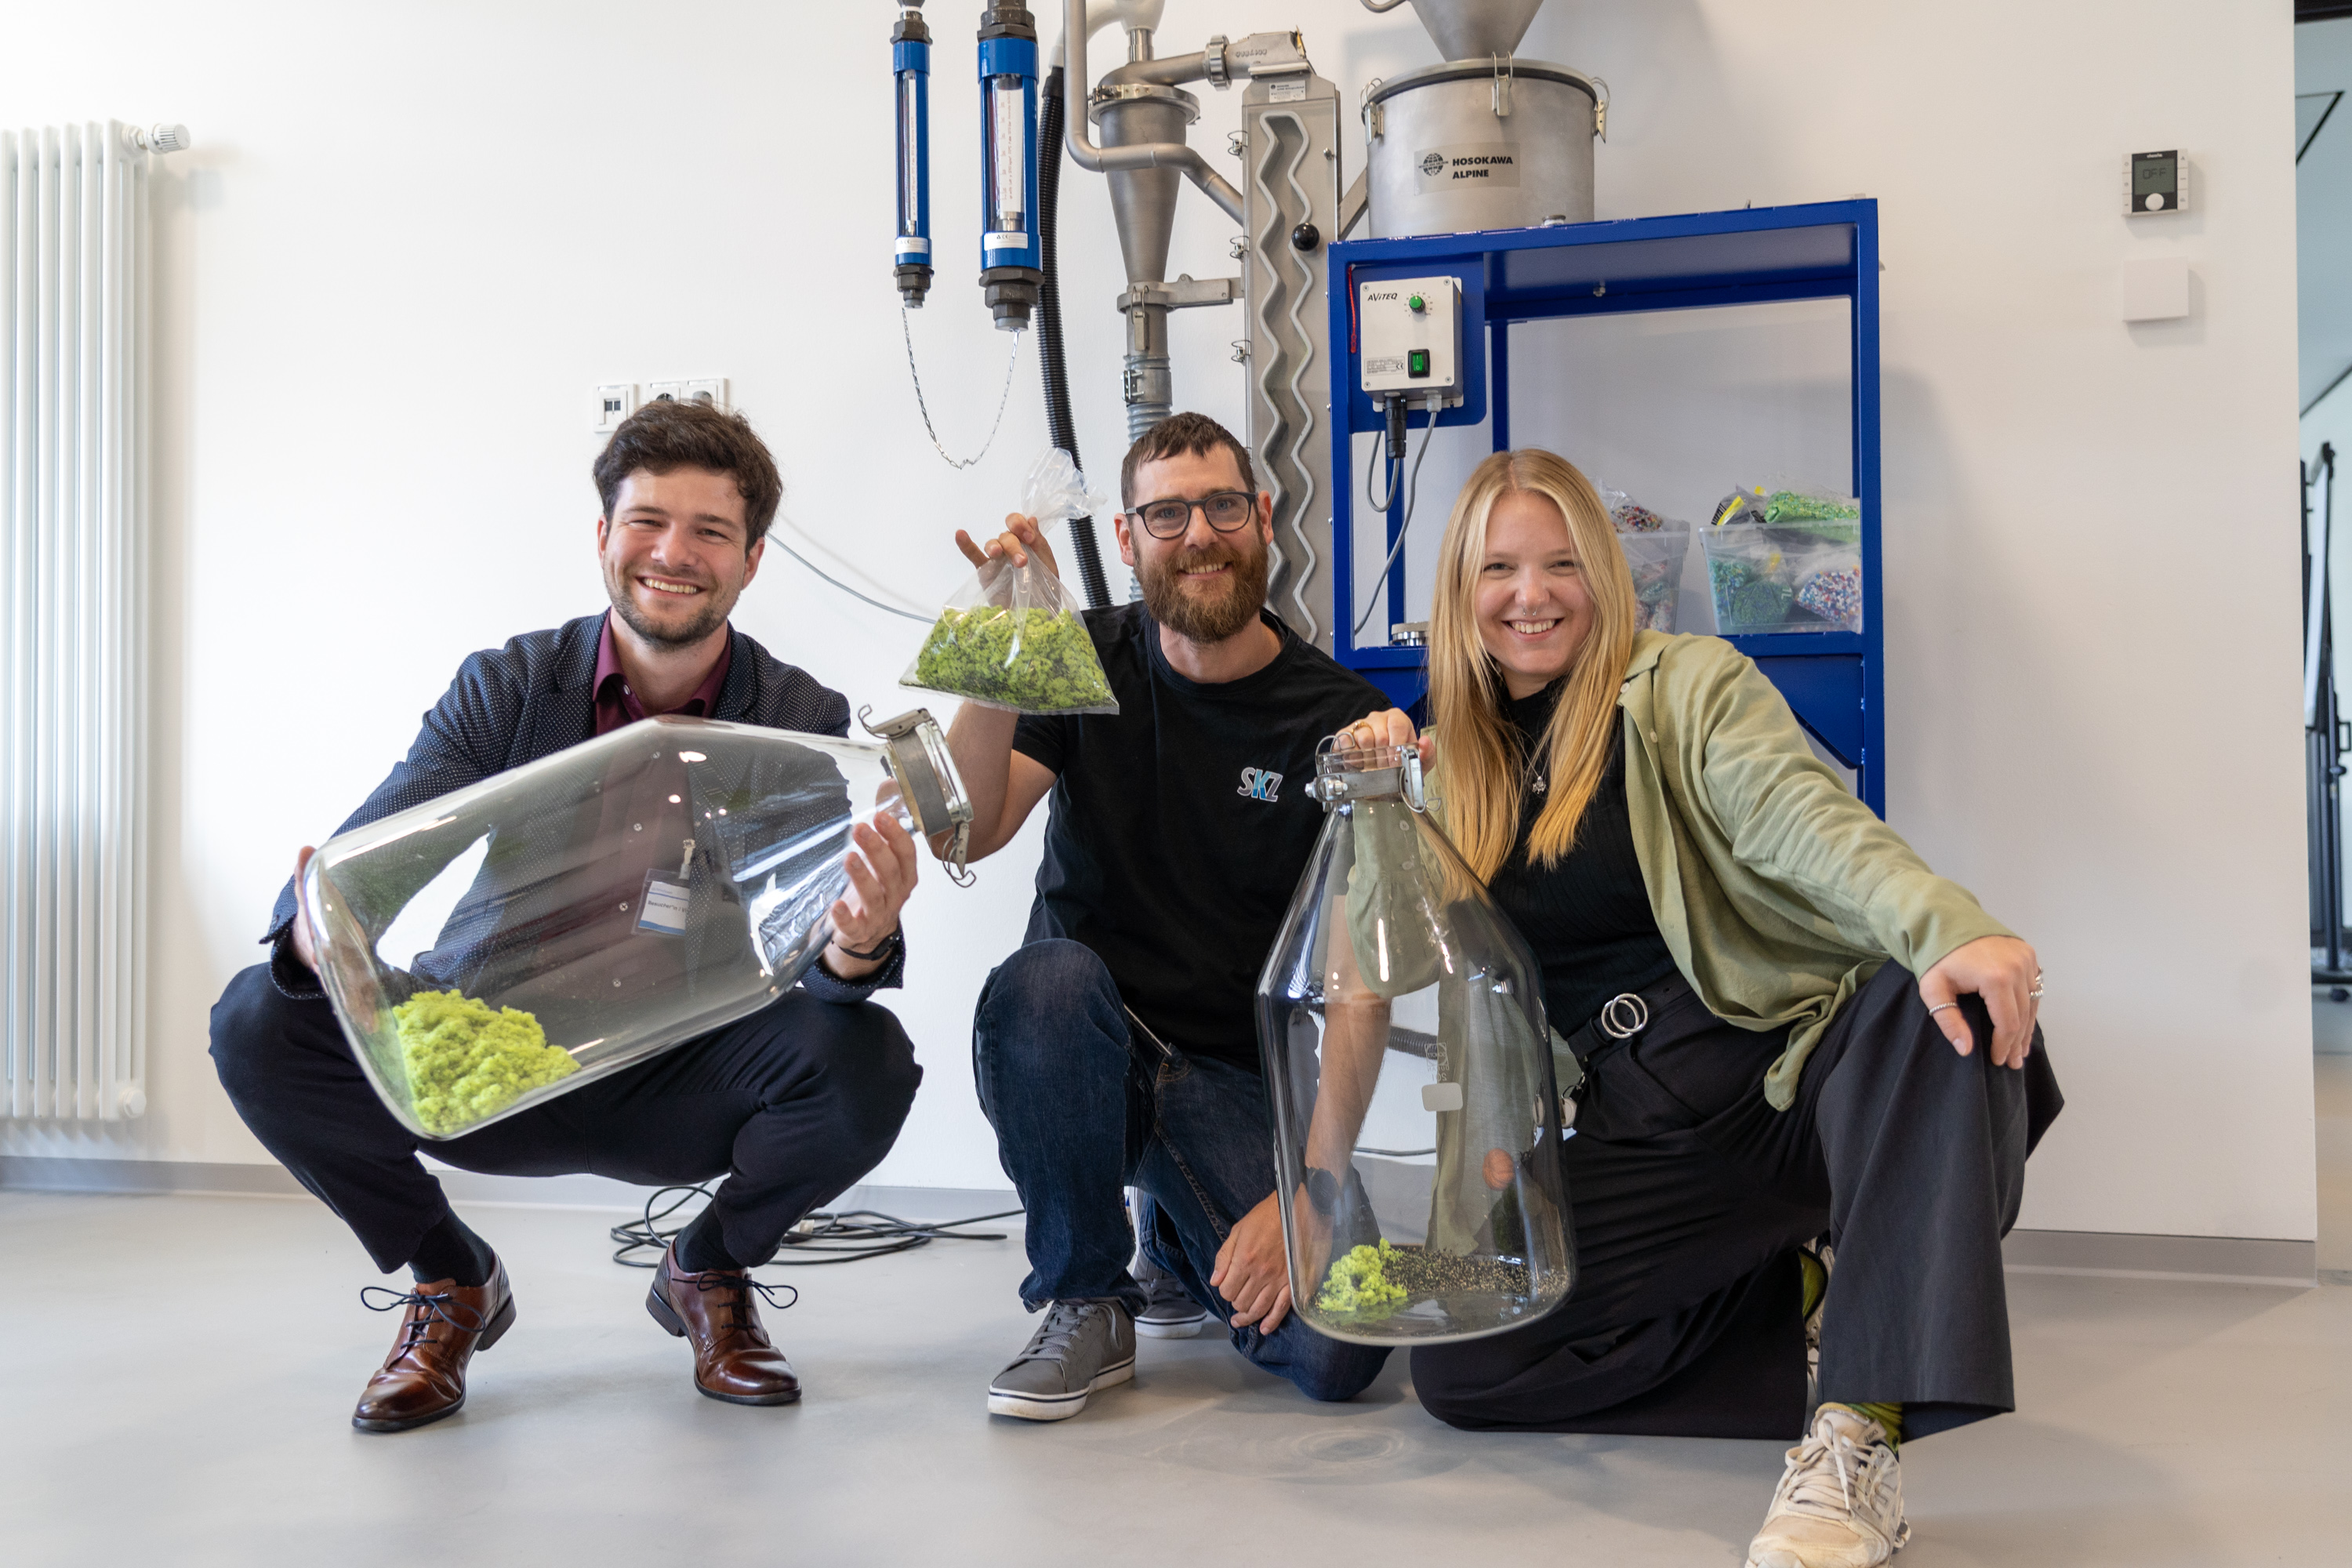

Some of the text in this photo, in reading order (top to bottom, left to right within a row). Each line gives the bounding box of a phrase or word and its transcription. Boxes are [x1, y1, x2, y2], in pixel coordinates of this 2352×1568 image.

[1452, 156, 1513, 166] HOSOKAWA
[1452, 169, 1489, 180] ALPINE
[2142, 167, 2167, 180] OFF
[1236, 766, 1283, 803] SKZ
